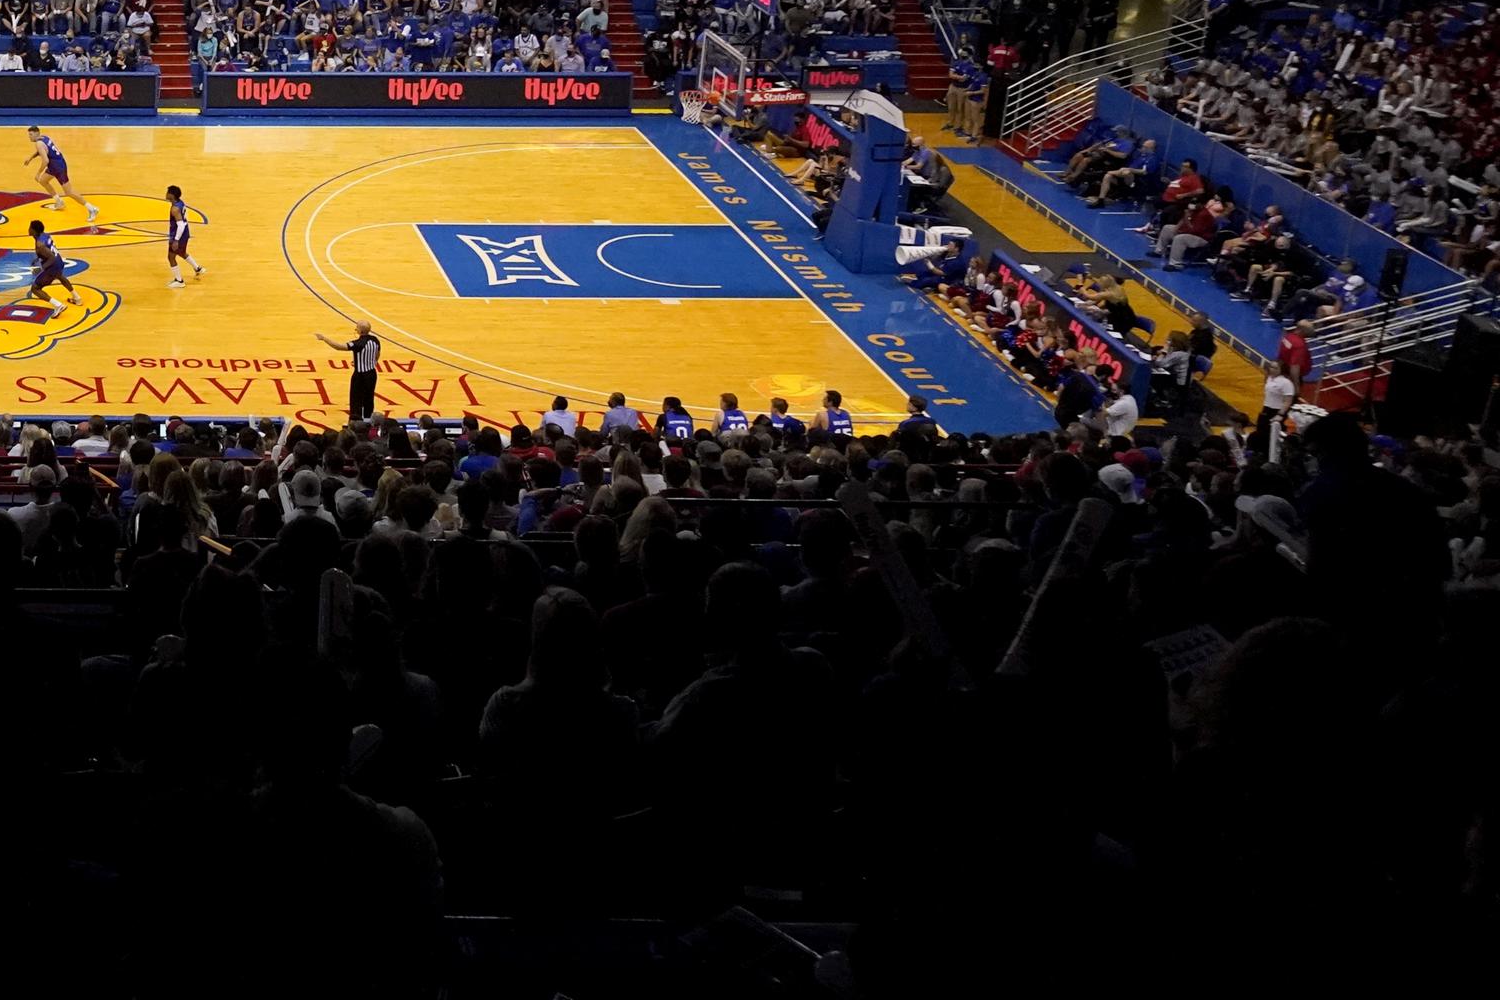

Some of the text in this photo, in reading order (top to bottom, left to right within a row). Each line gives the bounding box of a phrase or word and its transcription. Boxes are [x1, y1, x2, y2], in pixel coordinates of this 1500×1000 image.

[48, 78, 122, 106] HyVee
[237, 78, 312, 106] HyVee
[388, 78, 463, 106] HyVee
[524, 78, 600, 106] HyVee
[677, 152, 967, 405] James Naismith Court
[117, 358, 417, 373] Alln Fieldhouse
